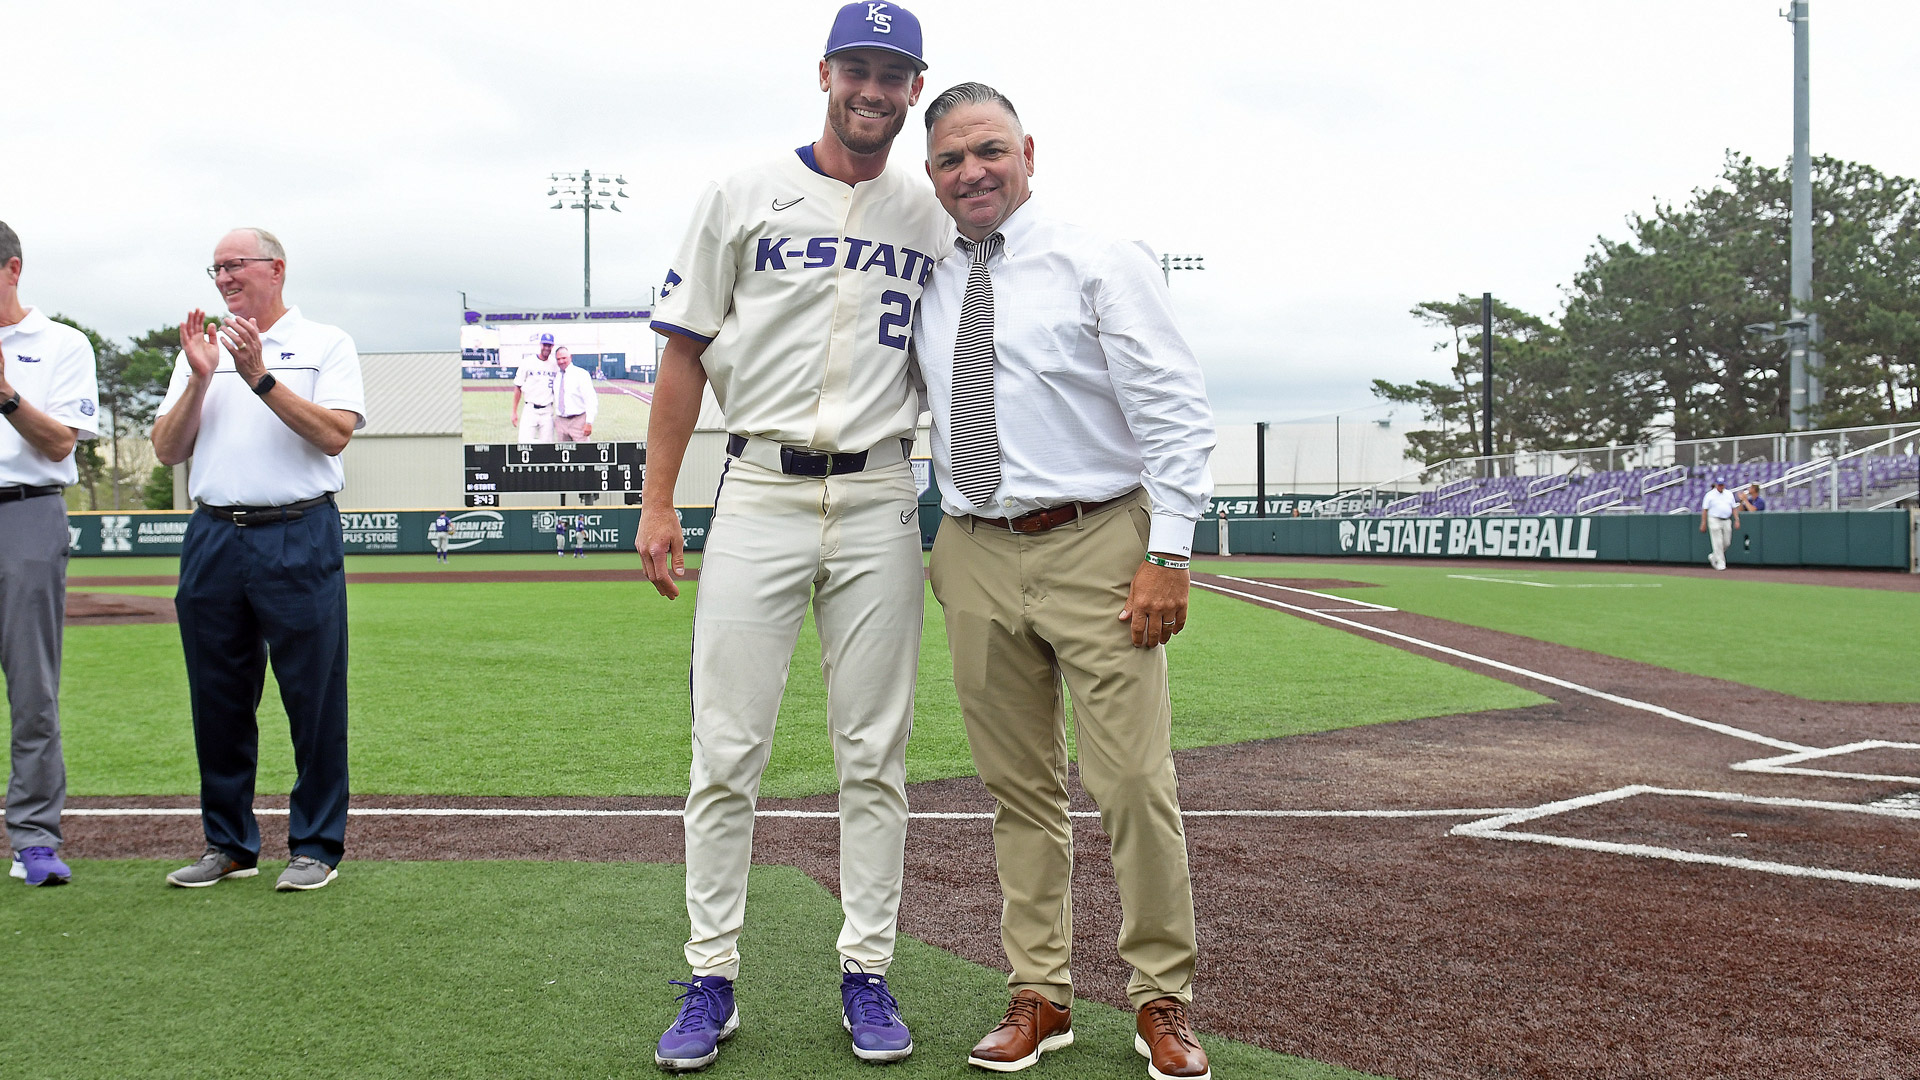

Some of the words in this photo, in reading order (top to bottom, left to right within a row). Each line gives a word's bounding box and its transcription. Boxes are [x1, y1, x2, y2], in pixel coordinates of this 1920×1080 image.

[754, 236, 935, 286] K-STATE
[485, 313, 539, 321] EDGERLEY
[542, 312, 580, 320] FAMILY
[584, 311, 650, 319] VIDEOBOARD
[878, 289, 912, 352] 2
[521, 451, 530, 463] 0
[562, 450, 570, 462] 0
[600, 450, 608, 462] 0
[601, 470, 608, 480] 0
[624, 470, 631, 480] 0
[601, 480, 608, 490] 0
[624, 480, 631, 490] 0
[474, 494, 495, 505] 3:43
[1298, 500, 1395, 514] BASEBAL
[480, 520, 505, 530] PEST
[364, 533, 398, 543] STORE
[486, 530, 504, 539] INC.
[1356, 519, 1444, 554] K-STATE
[1448, 518, 1597, 558] BASEBALL
